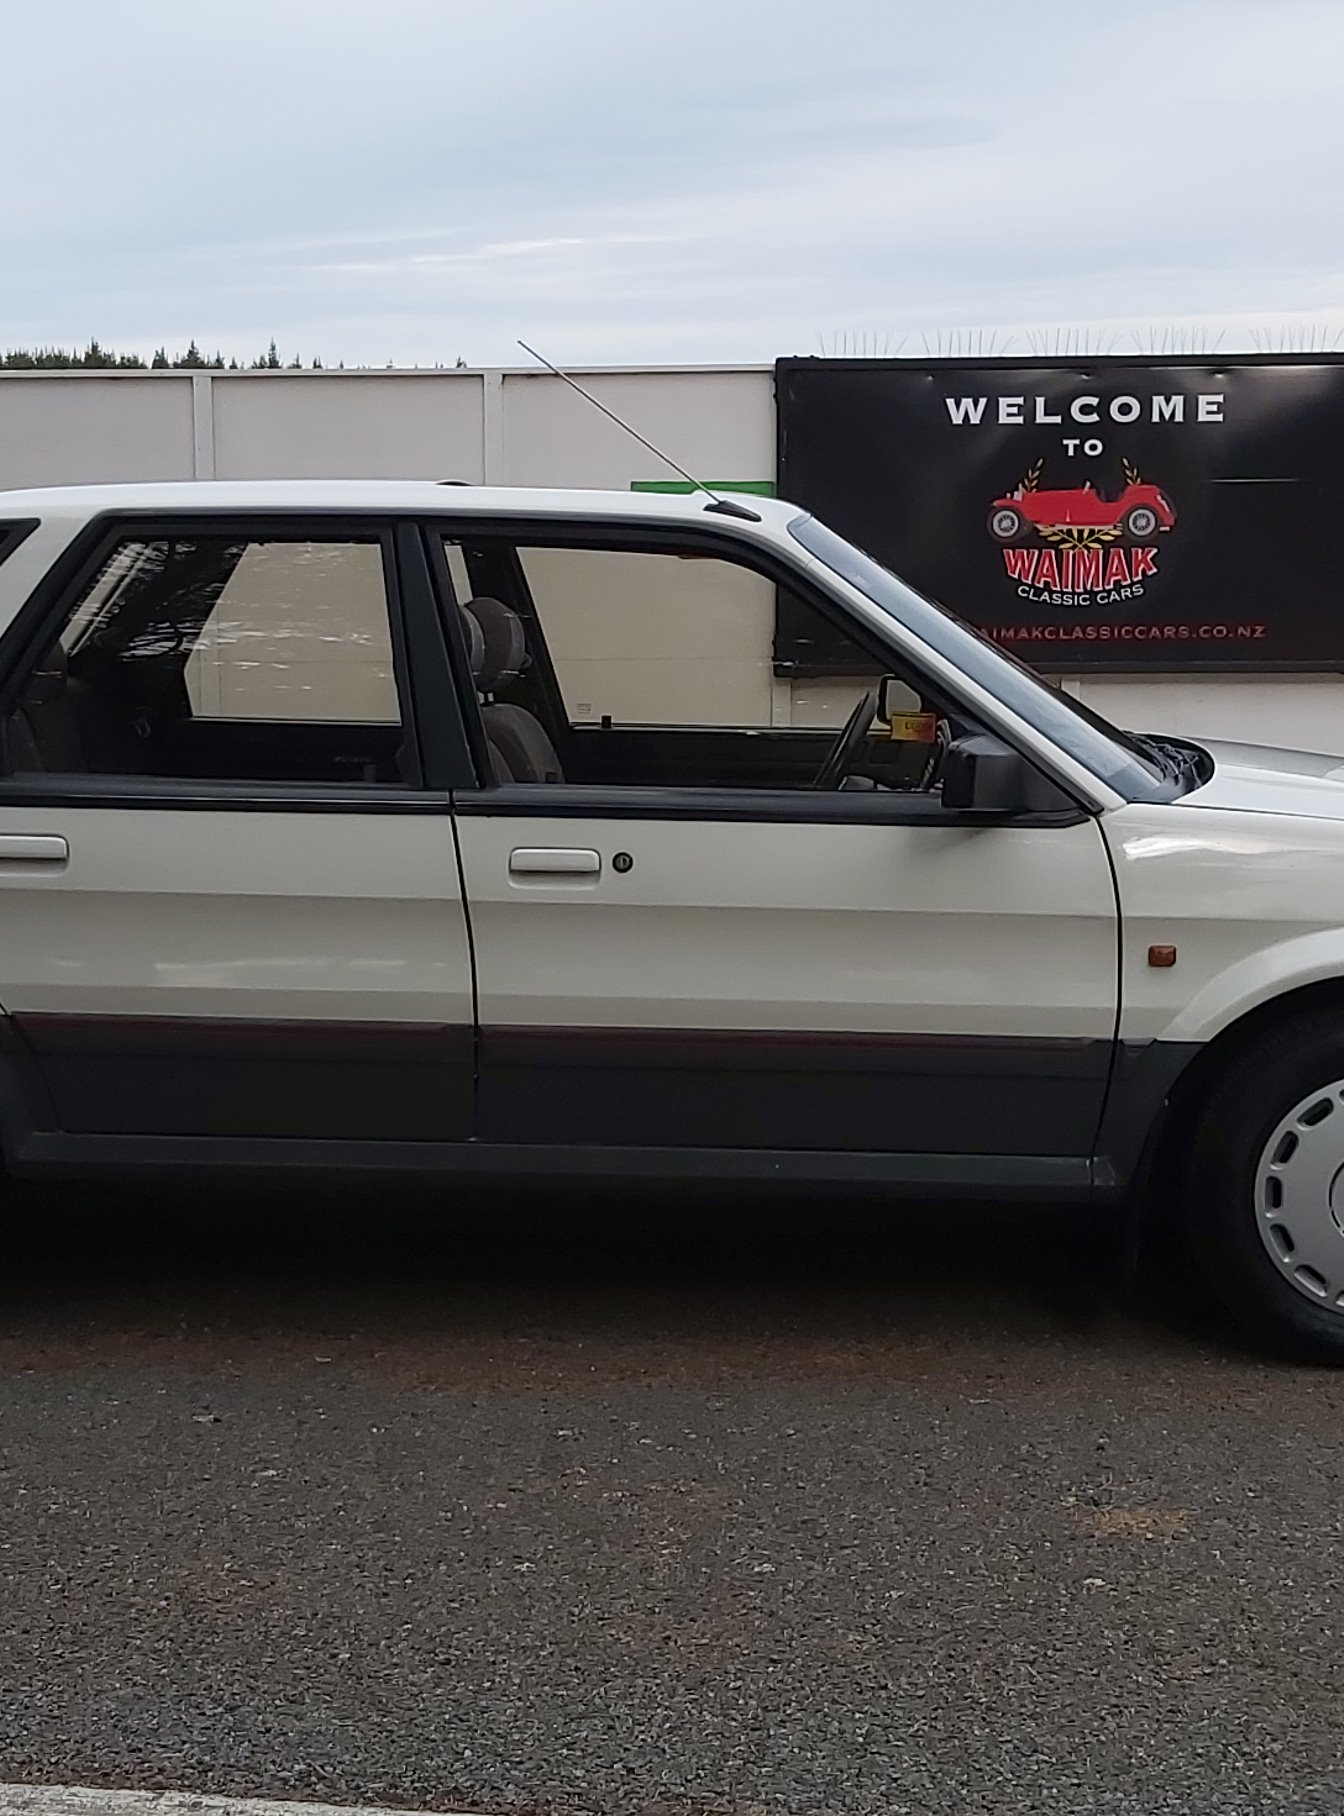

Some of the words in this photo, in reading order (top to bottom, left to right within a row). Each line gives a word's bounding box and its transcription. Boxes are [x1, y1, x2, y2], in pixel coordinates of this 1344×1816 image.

[945, 394, 1224, 425] WELCOME
[1062, 438, 1103, 456] TO
[1002, 547, 1158, 592] WAIMAK
[1017, 585, 1090, 606] CLASSIC
[1096, 583, 1144, 605] CARS
[978, 626, 1266, 640] AIMAKCLASSICCARS.CO.NZ
